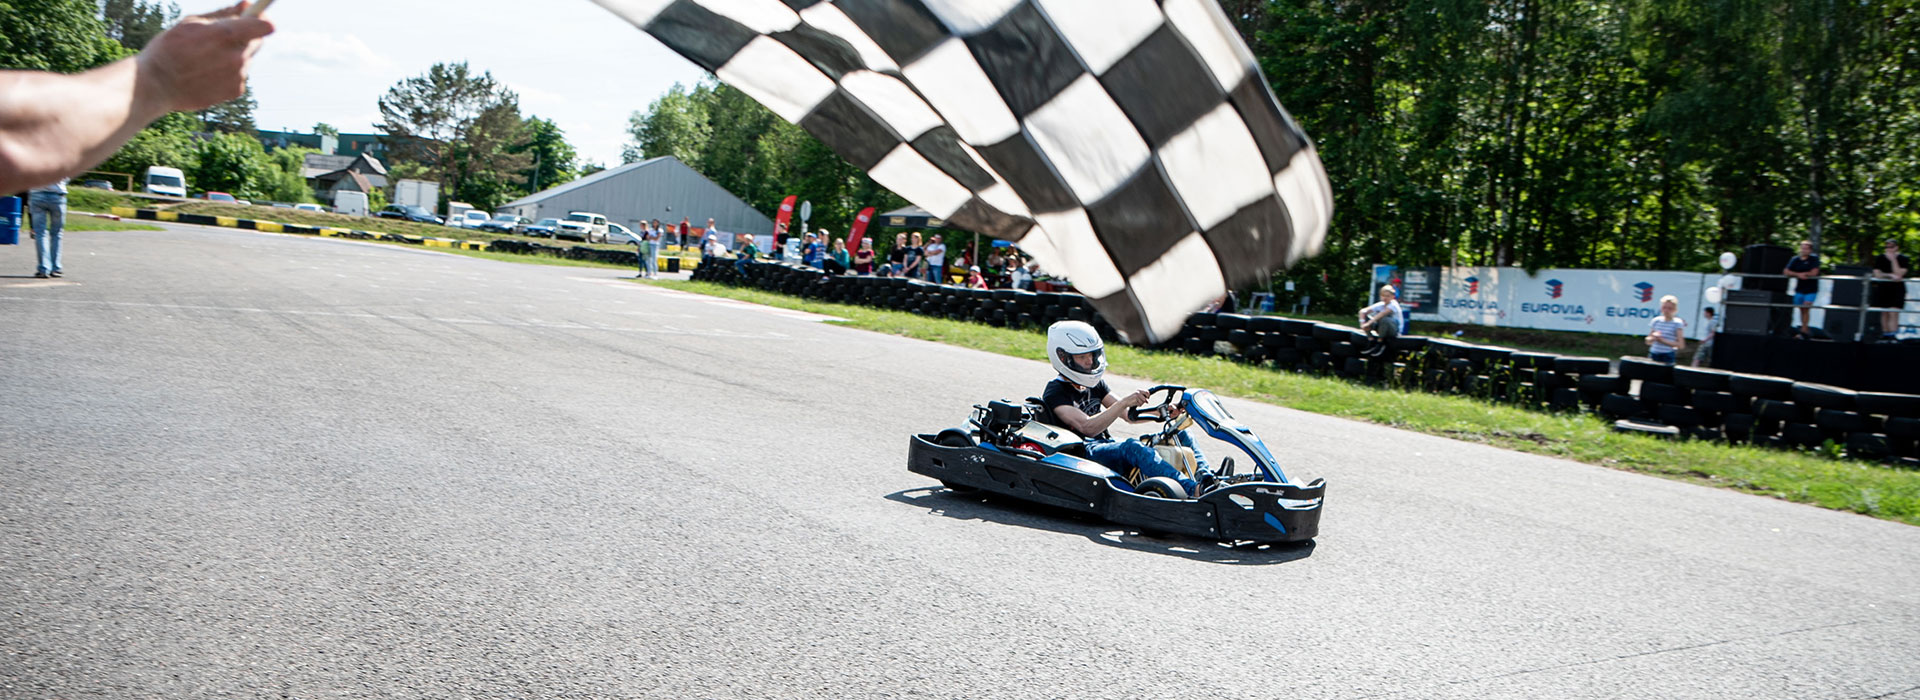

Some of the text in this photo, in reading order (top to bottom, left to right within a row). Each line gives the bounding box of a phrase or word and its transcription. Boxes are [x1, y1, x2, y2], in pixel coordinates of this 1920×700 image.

[1443, 298, 1498, 310] EUROVIA
[1521, 302, 1585, 315] EUROVIA
[1606, 306, 1662, 319] EUROV
